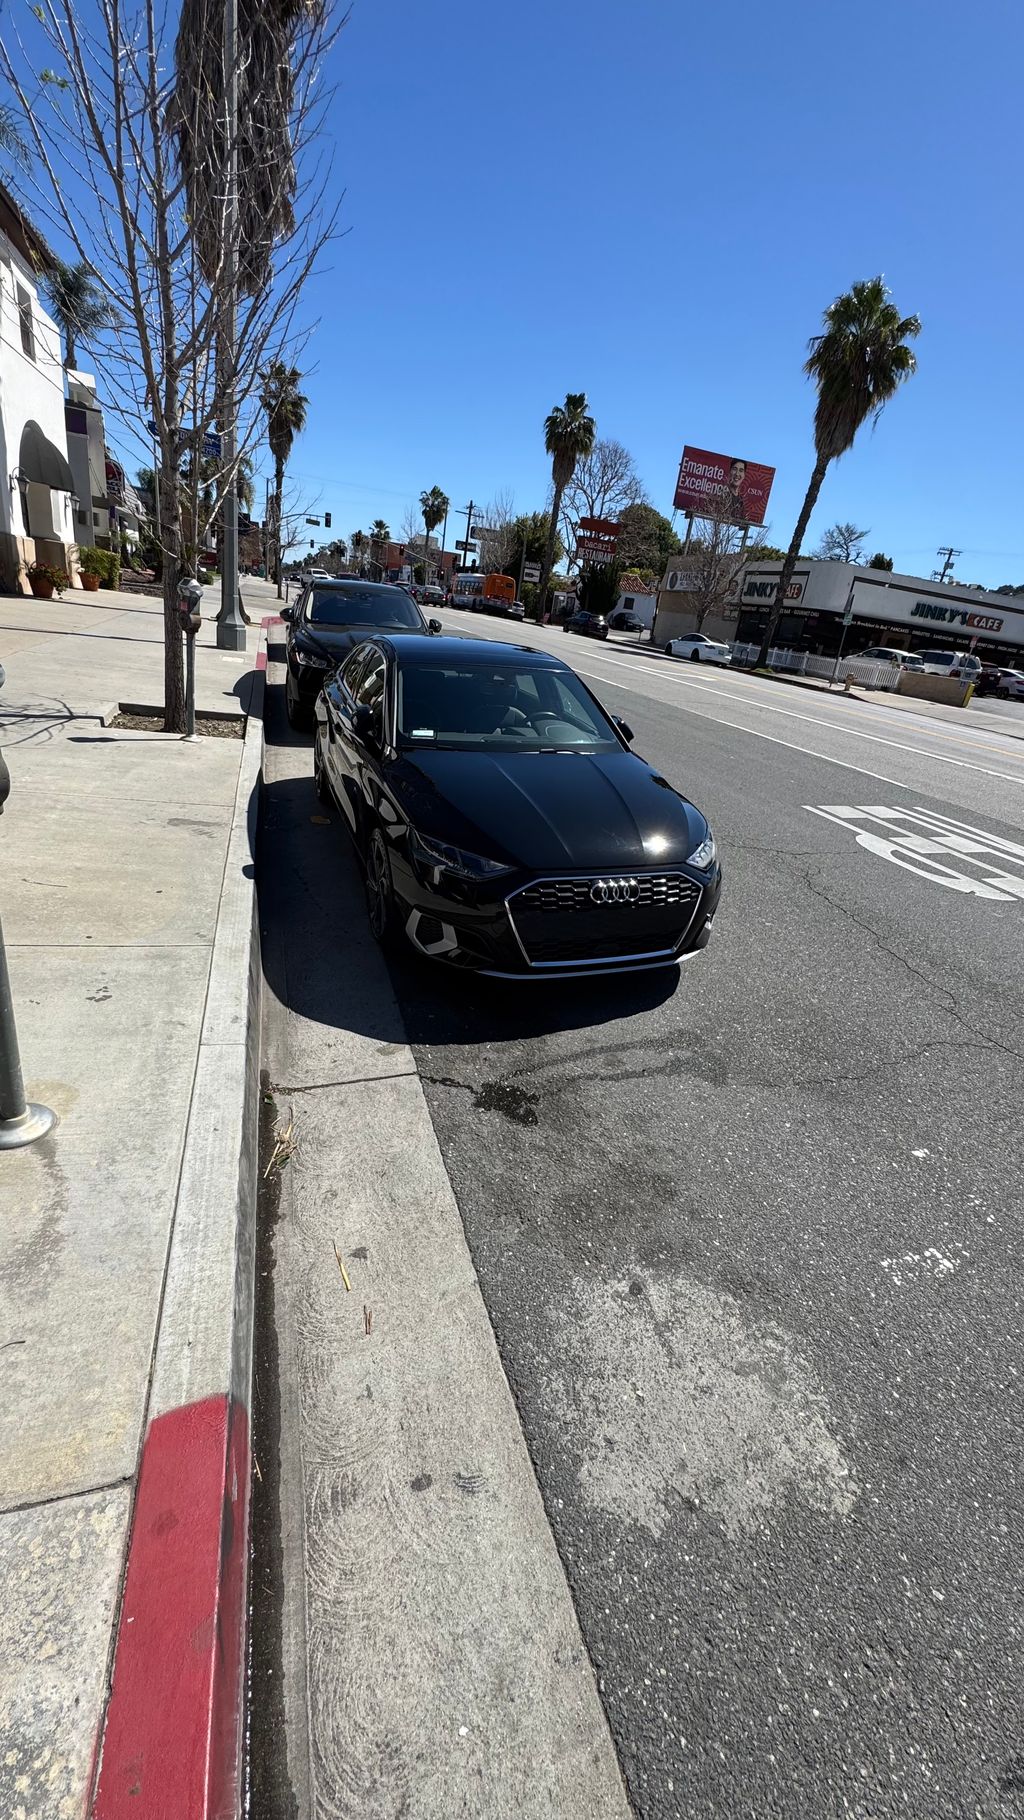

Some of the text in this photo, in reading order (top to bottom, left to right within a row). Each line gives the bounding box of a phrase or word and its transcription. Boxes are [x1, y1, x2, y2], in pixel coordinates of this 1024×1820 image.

[682, 457, 724, 480] Emanate
[679, 473, 730, 497] Excellence
[747, 487, 763, 497] CSUN
[584, 538, 612, 552] bacari
[578, 547, 615, 563] RESTAURANT
[785, 584, 800, 598] AFE
[910, 602, 1001, 631] JINKY'S CAFE
